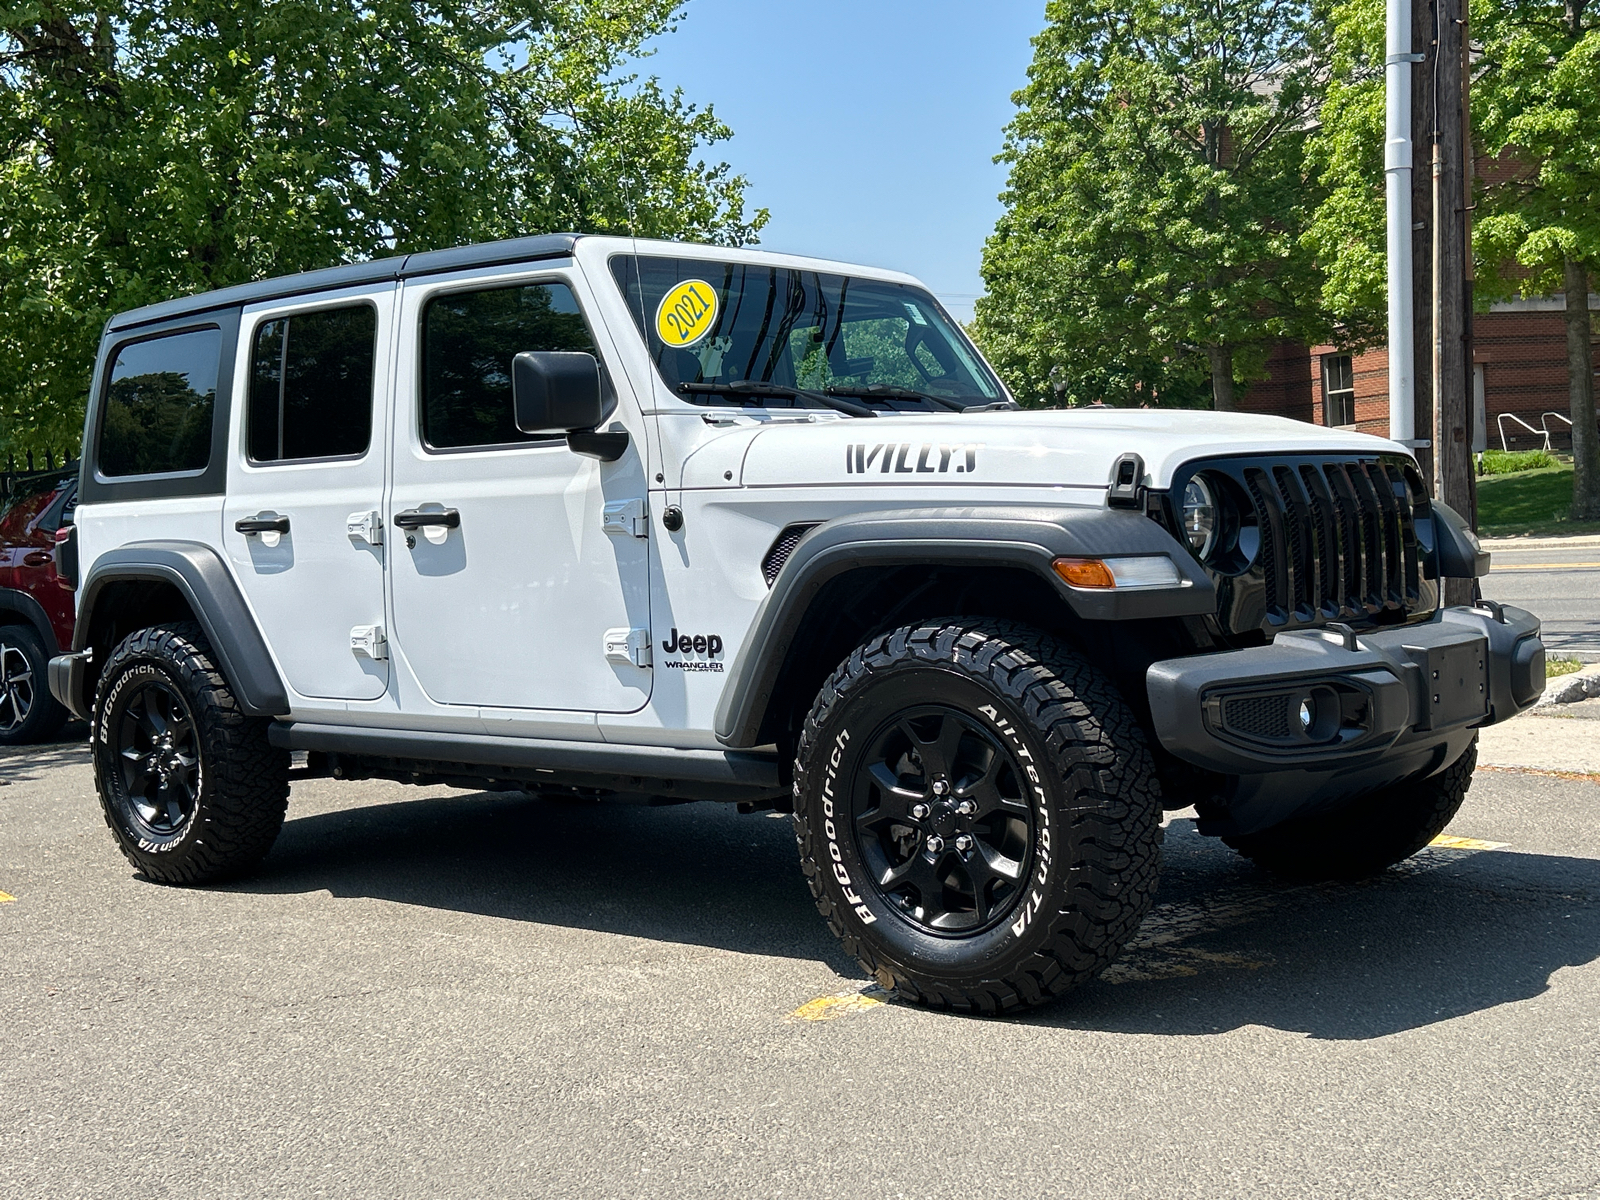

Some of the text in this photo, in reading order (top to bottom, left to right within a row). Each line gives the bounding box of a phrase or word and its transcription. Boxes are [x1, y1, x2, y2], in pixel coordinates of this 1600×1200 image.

[667, 285, 710, 340] 2021
[662, 628, 723, 658] Jeep
[664, 661, 724, 669] WRANGLER
[100, 664, 155, 745] BFGoodrich
[822, 728, 878, 925] BFGoodrich
[978, 703, 1052, 885] All-Terrain
